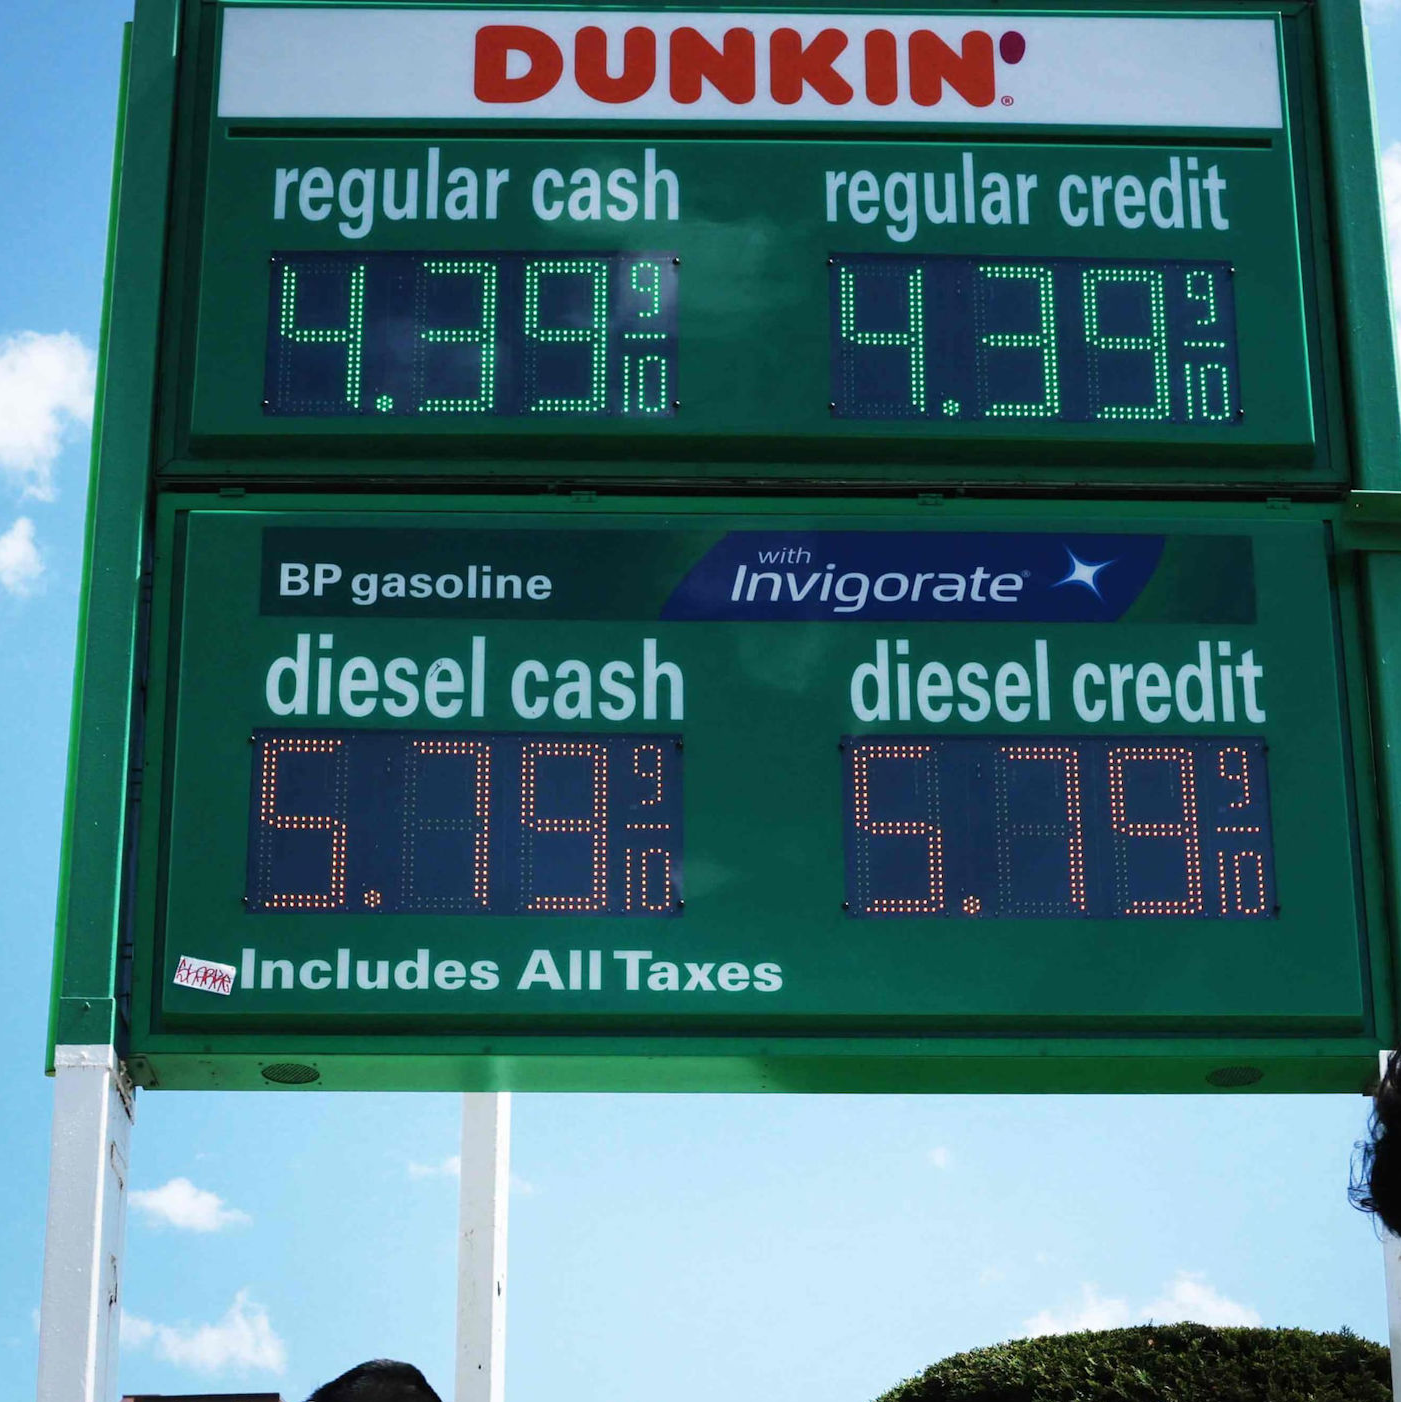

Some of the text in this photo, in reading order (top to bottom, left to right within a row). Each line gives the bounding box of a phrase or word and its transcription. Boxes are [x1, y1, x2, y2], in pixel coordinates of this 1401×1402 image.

[474, 25, 1025, 107] DUNKIN'
[273, 147, 679, 239] regular cash
[825, 152, 1229, 242] regular credit
[280, 261, 607, 412] 4.39
[840, 265, 1170, 420] 4.39
[279, 563, 553, 605] BP gasoline
[731, 563, 1026, 613] Invigorate
[758, 547, 811, 564] with
[265, 633, 684, 721] diesel cash
[850, 639, 1266, 724] diesel credit
[260, 738, 608, 911] 5.79
[853, 744, 1203, 916] 5.79
[241, 948, 784, 992] Includes All Taxes
